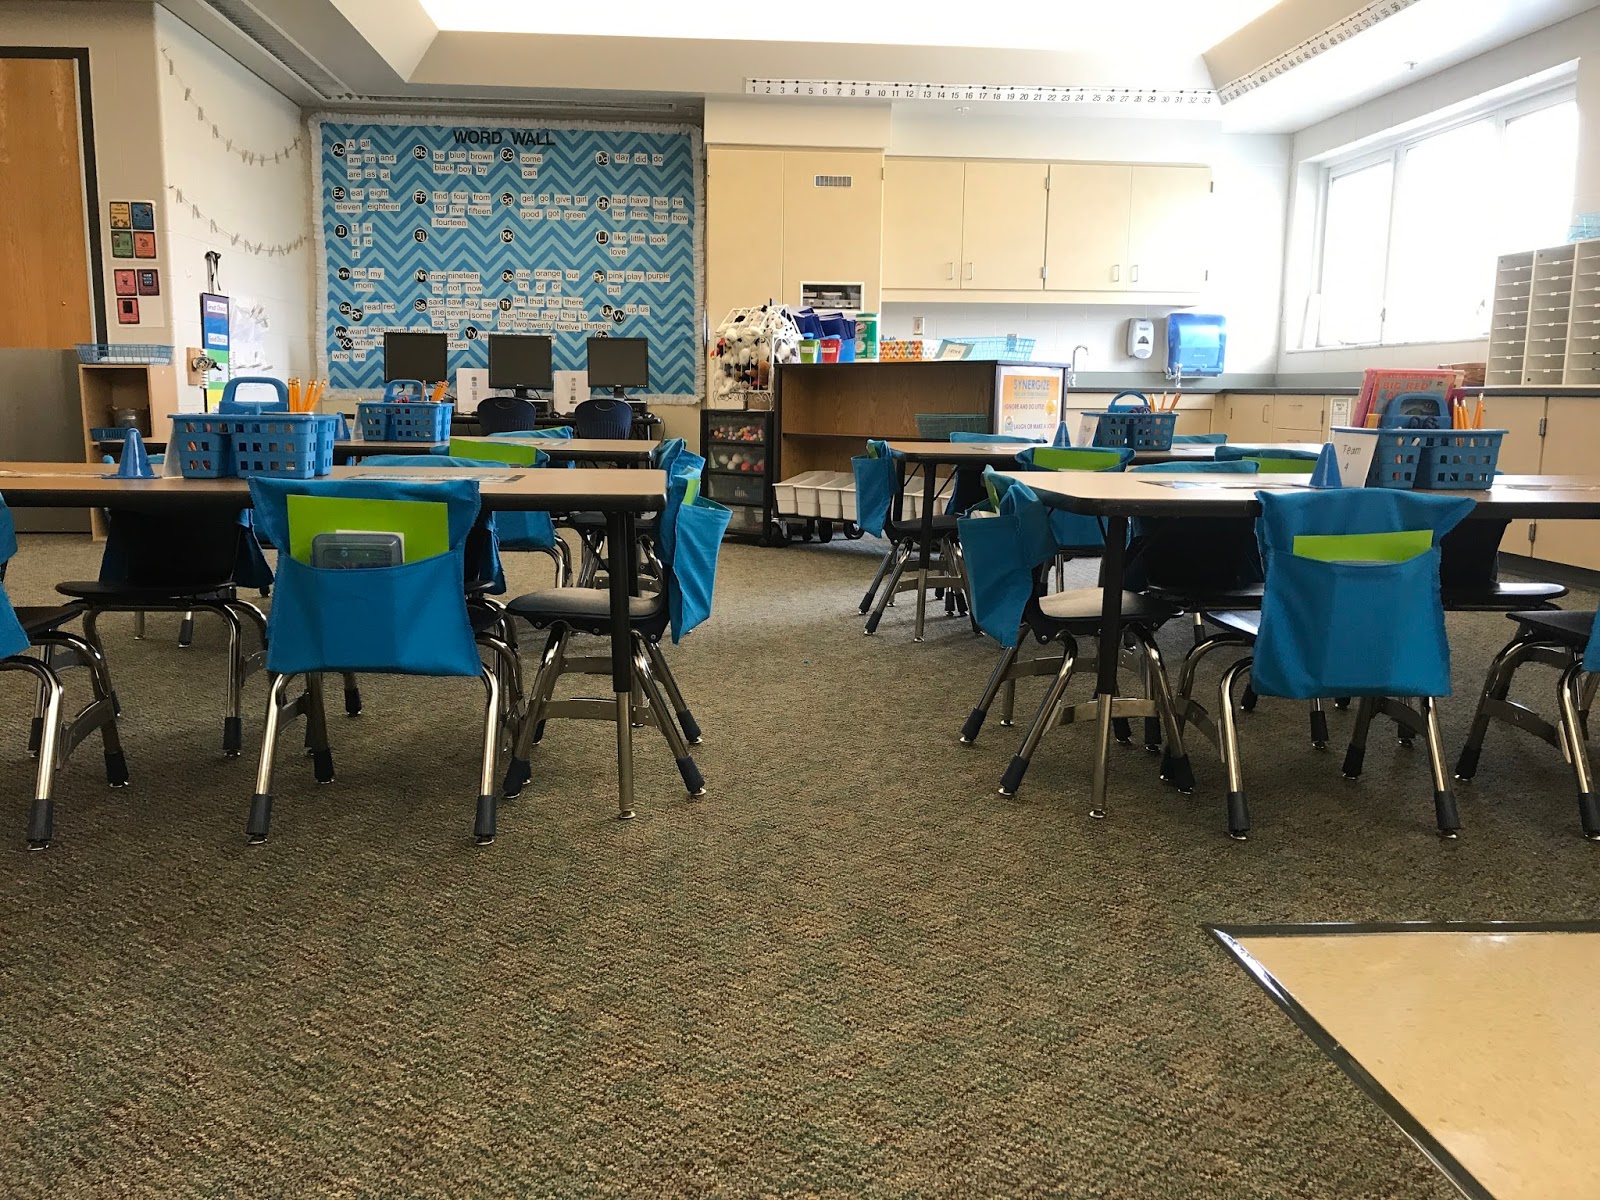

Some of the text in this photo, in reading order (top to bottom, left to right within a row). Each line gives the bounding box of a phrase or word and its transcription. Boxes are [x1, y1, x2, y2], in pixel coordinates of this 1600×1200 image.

[453, 130, 556, 146] WORD WALL
[414, 148, 427, 156] Bb
[470, 152, 493, 160] brown
[502, 151, 513, 159] Cc
[616, 154, 629, 162] day
[635, 155, 647, 163] did
[434, 164, 453, 172] black
[334, 188, 345, 196] Ee
[370, 189, 388, 197] eight
[414, 193, 425, 201] Ff
[521, 195, 534, 203] get
[555, 196, 571, 204] give
[576, 196, 587, 204] girl
[613, 196, 626, 204] had
[521, 211, 586, 220] good got green
[672, 213, 687, 221] how
[502, 231, 513, 240] Kk
[465, 301, 479, 309] say
[501, 300, 511, 309] Tt
[529, 297, 543, 305] that
[500, 311, 517, 319] then
[542, 313, 558, 321] they
[498, 320, 510, 328] too
[529, 321, 552, 330] twenty
[556, 323, 579, 331] twelve
[1014, 379, 1050, 390] SYNERGIZE
[1406, 382, 1428, 390] RED
[1343, 445, 1361, 455] Team
